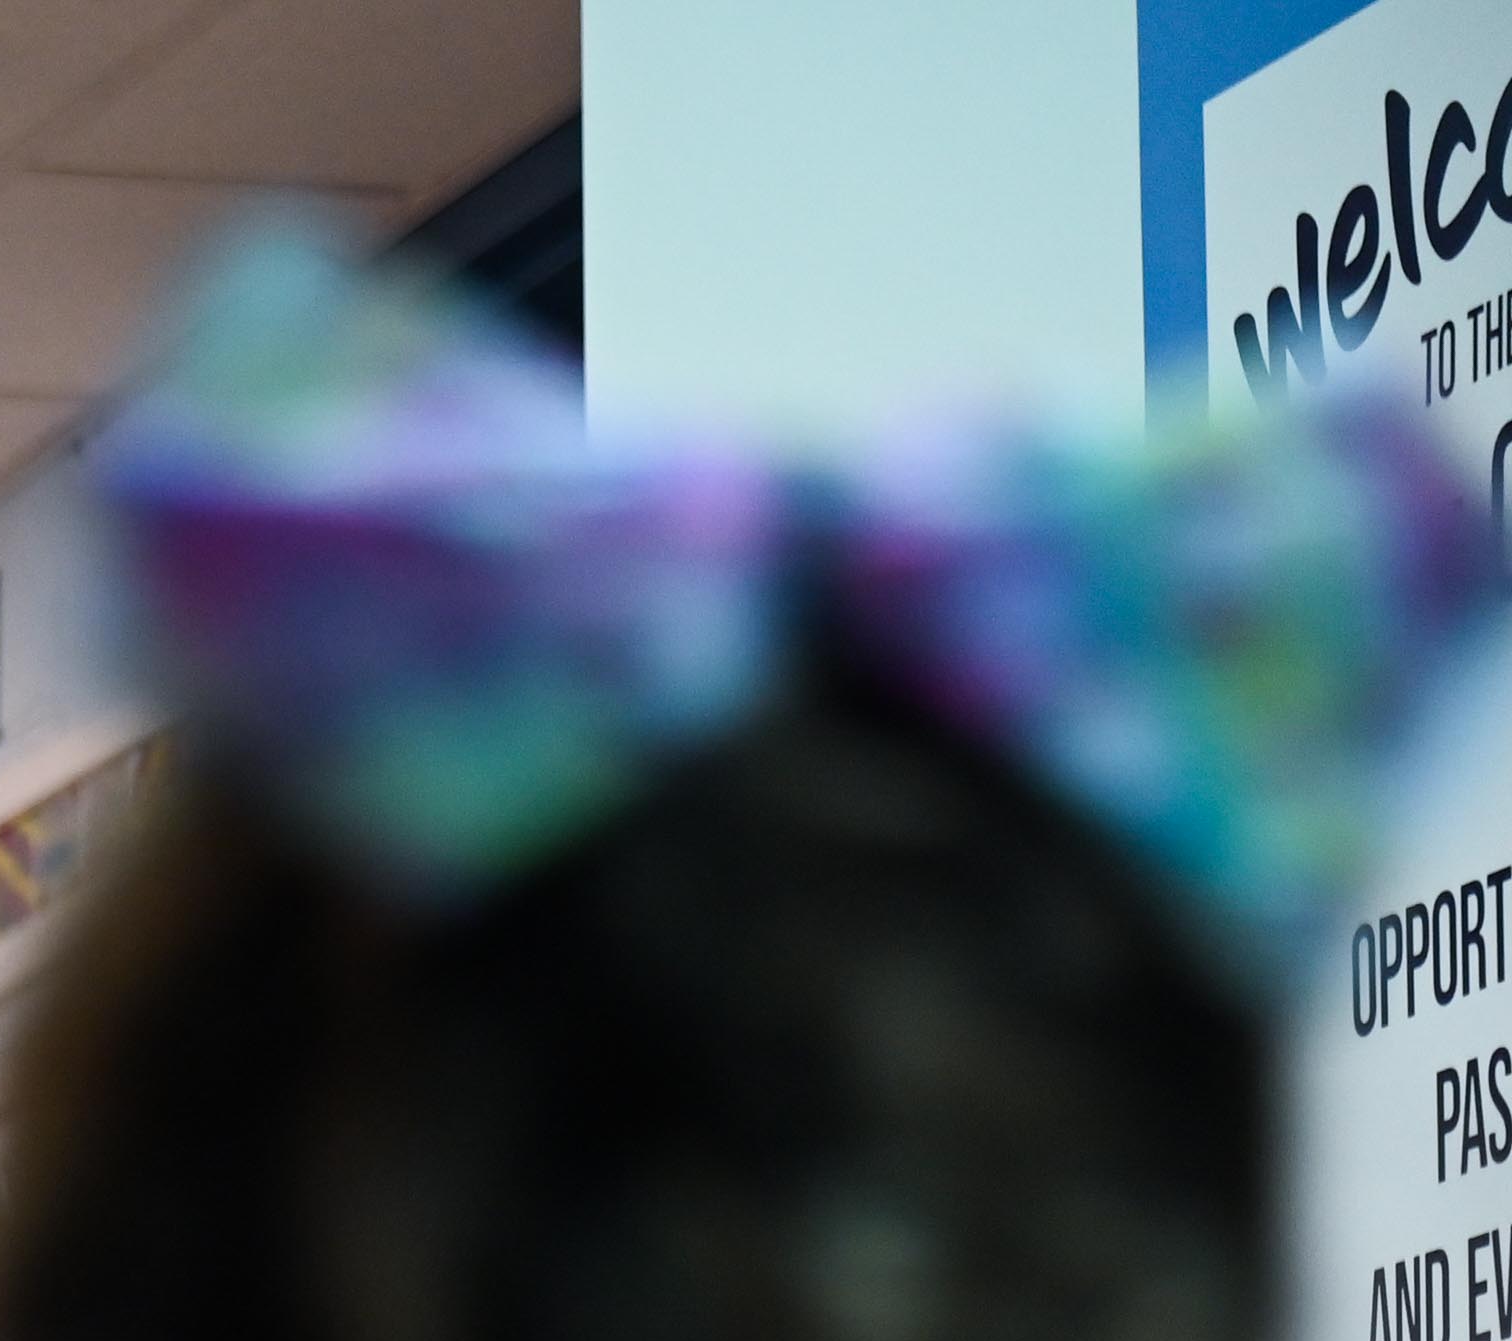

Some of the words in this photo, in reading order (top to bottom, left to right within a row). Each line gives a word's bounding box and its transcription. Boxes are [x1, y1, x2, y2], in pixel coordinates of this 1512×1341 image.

[1421, 319, 1456, 408] TO
[1352, 865, 1512, 1038] OPPORT
[1436, 1046, 1512, 1184] PAS
